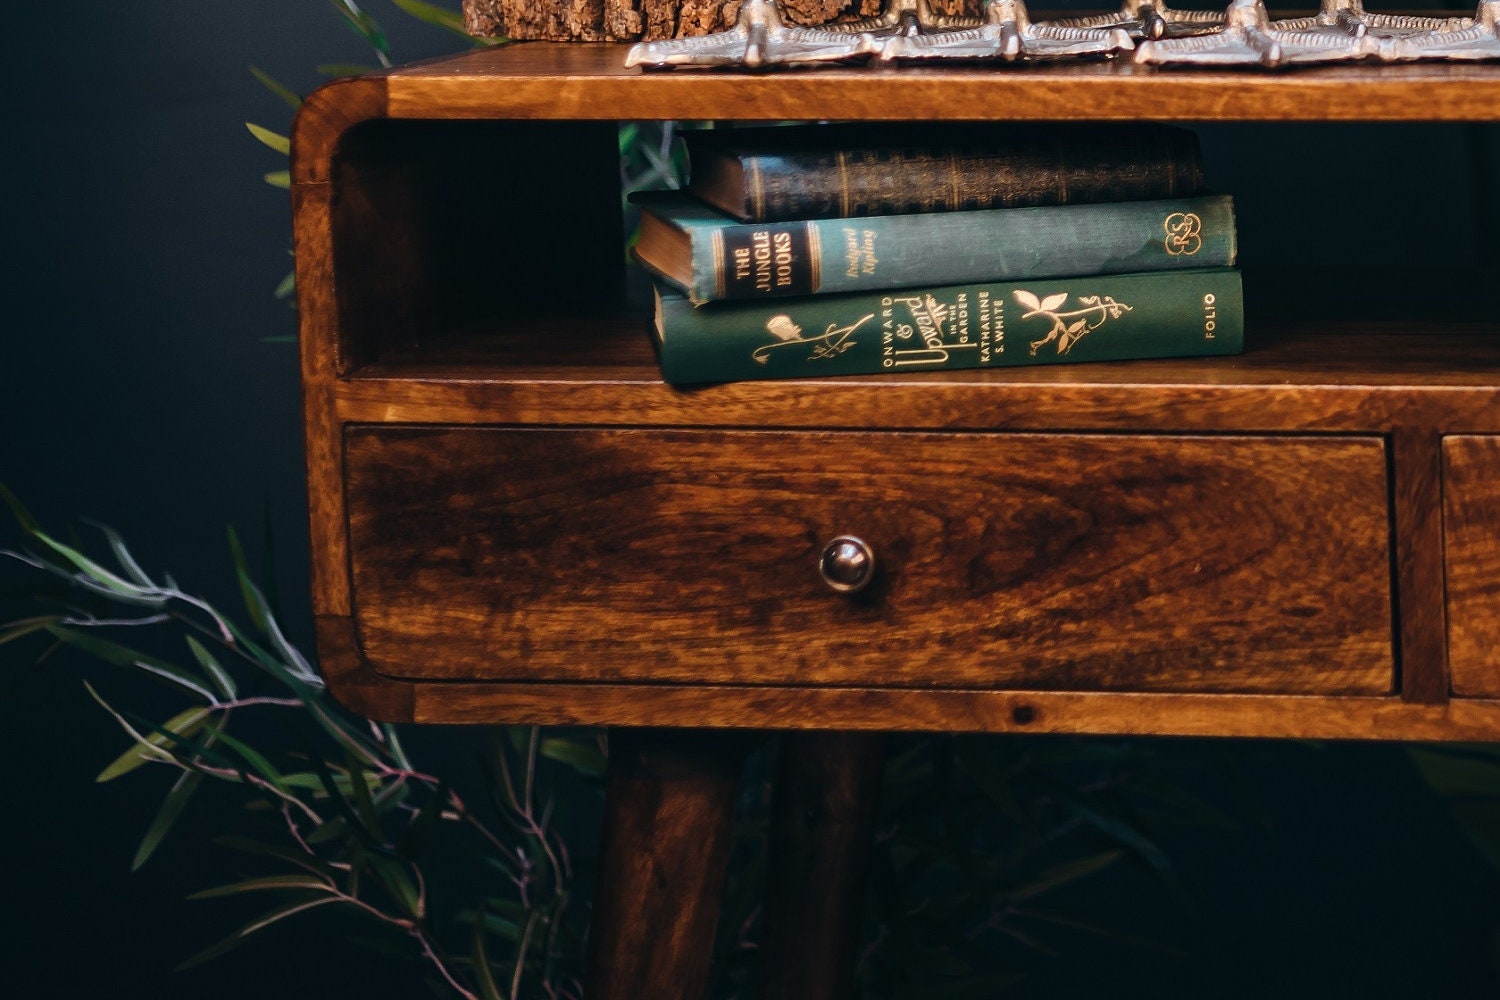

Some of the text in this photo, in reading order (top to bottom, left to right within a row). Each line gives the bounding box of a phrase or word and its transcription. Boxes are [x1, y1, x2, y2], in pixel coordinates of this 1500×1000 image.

[733, 247, 750, 280] THE
[752, 230, 772, 292] JUNGLE
[774, 231, 792, 287] BOOKS
[843, 227, 859, 278] Rudyard
[861, 229, 879, 275] Kipling
[881, 296, 893, 368] ONWARD
[894, 296, 978, 367] Upward
[896, 323, 913, 339] &
[949, 304, 957, 335] IN THE
[958, 292, 969, 344] GARDEN
[979, 290, 991, 363] KATHARINE
[993, 299, 1005, 342] WHITE
[1204, 292, 1216, 339] FOLIO
